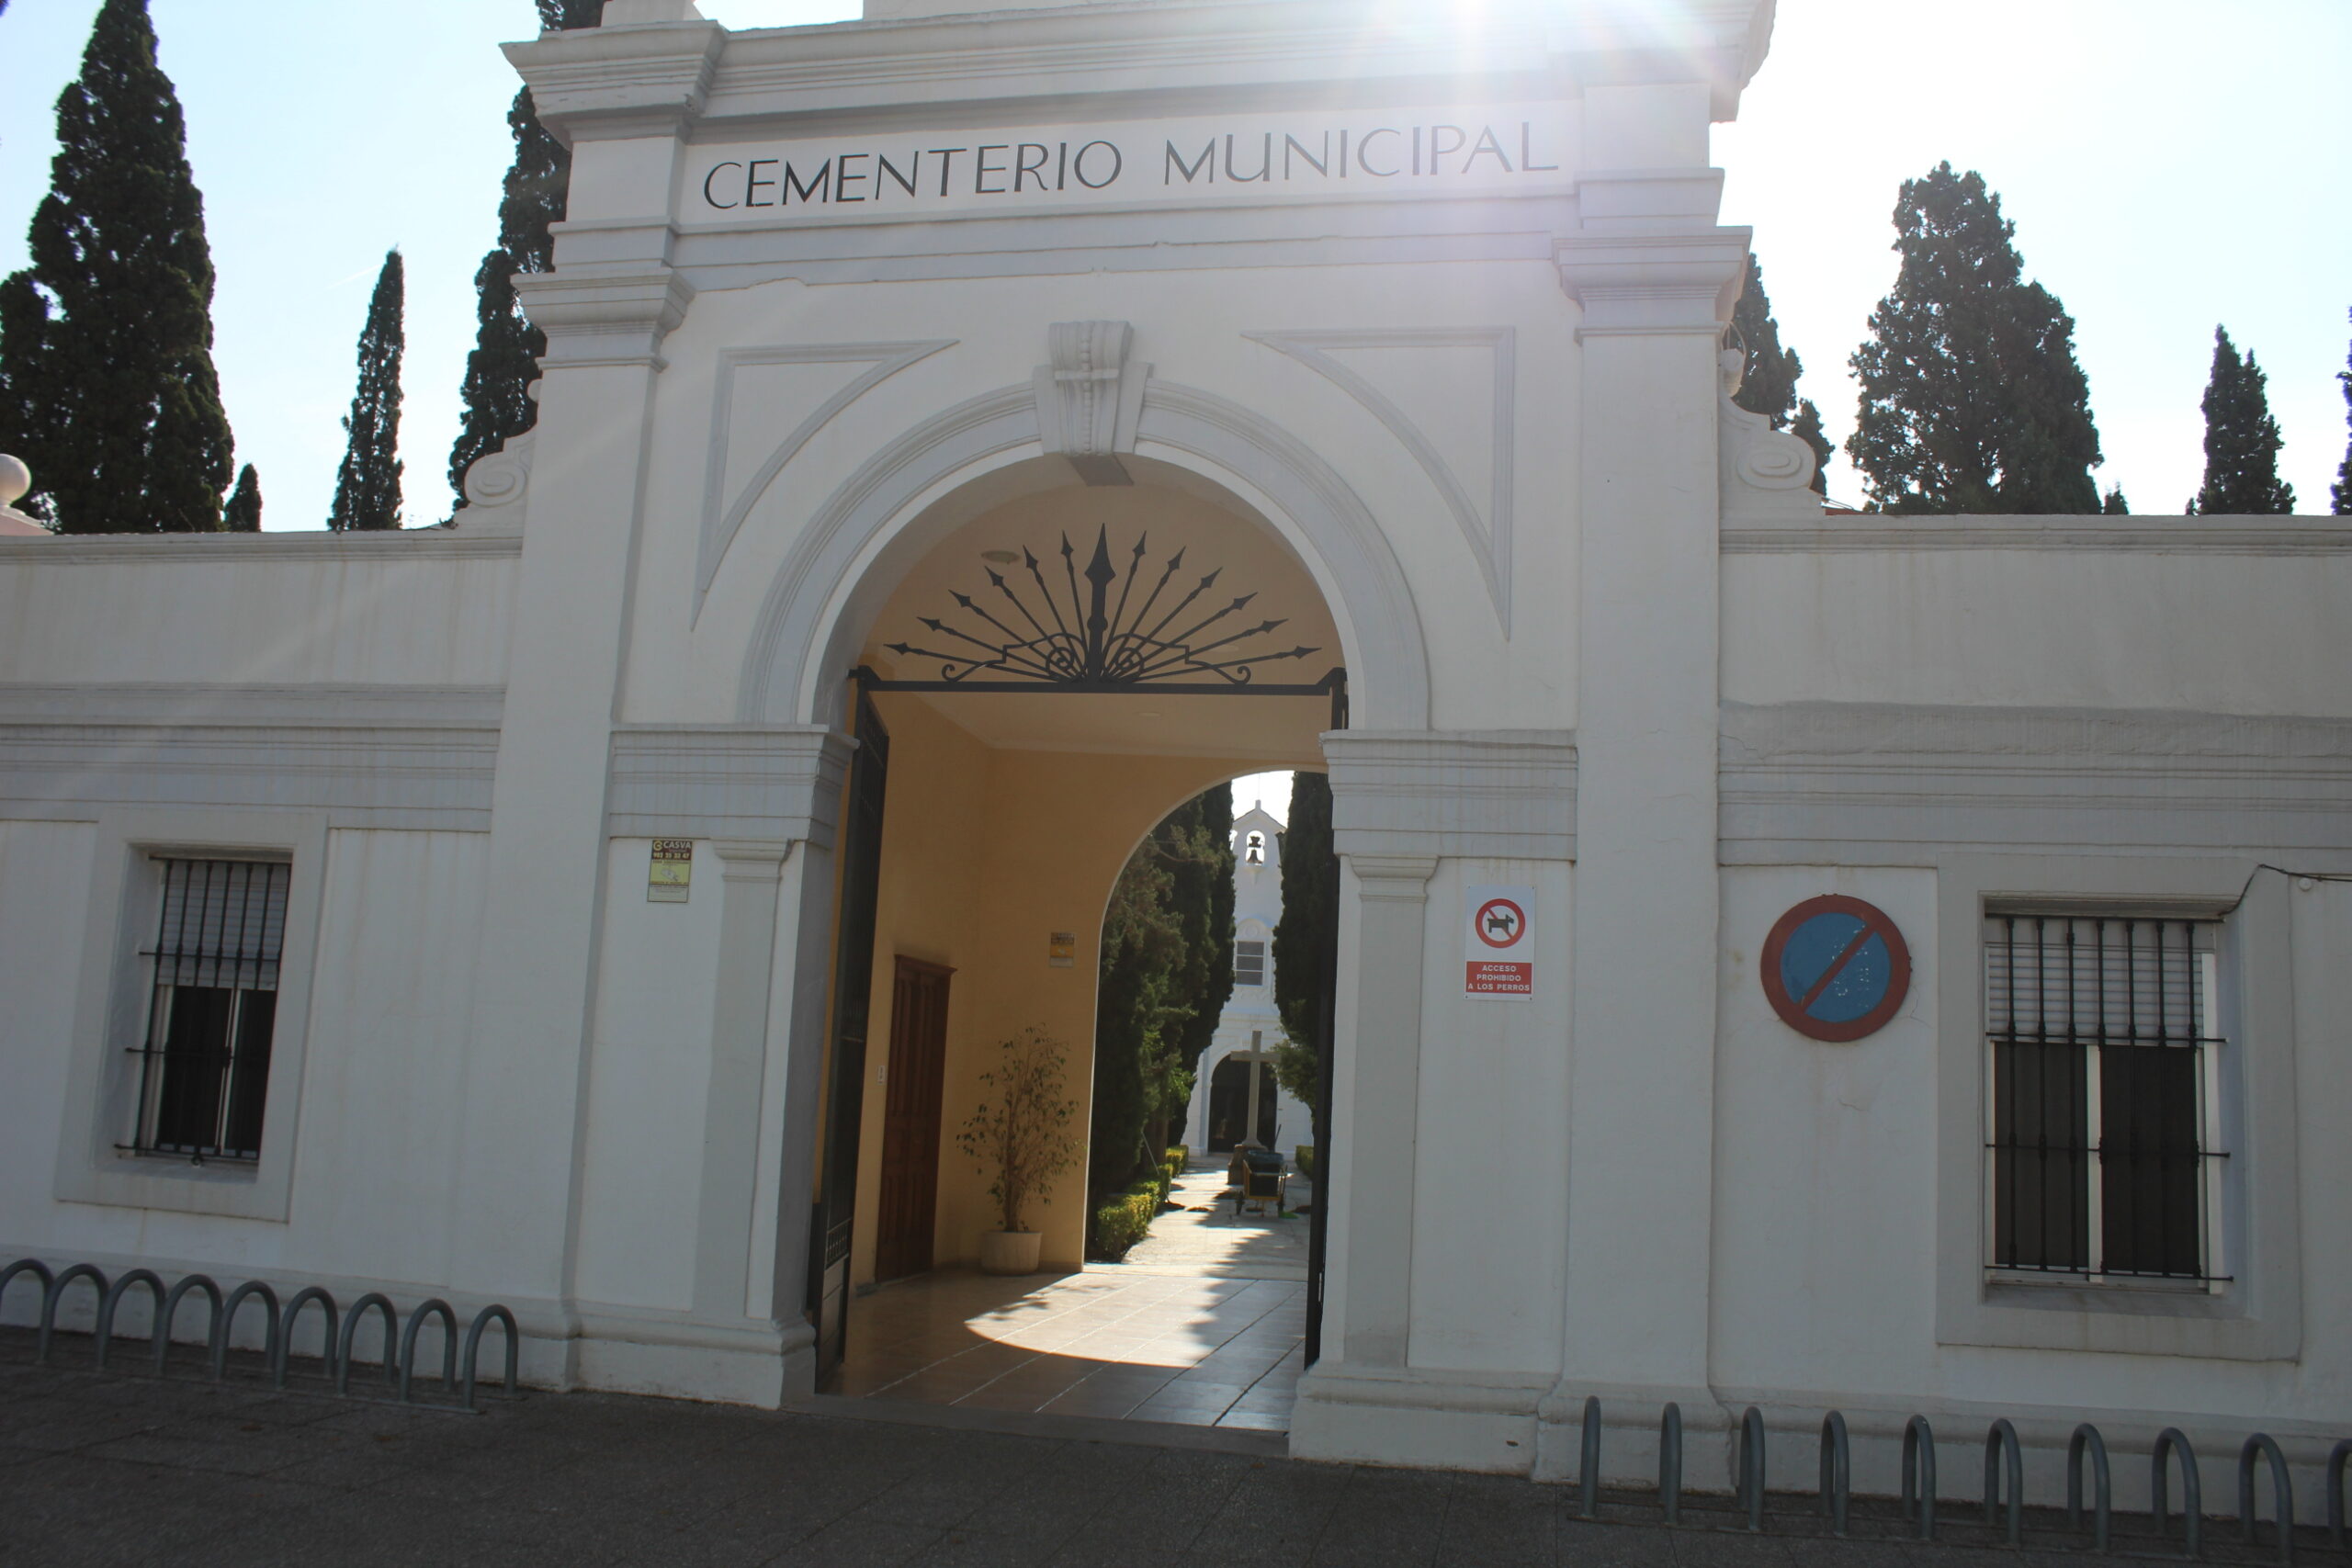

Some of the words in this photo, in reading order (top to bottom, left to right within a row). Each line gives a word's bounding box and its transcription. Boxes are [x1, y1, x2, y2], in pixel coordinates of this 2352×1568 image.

[704, 141, 1122, 209] CEMENTERIO
[1164, 121, 1559, 185] MUNICIPAL
[662, 840, 691, 850] CASVA
[1476, 974, 1521, 982] PROHIBIDO
